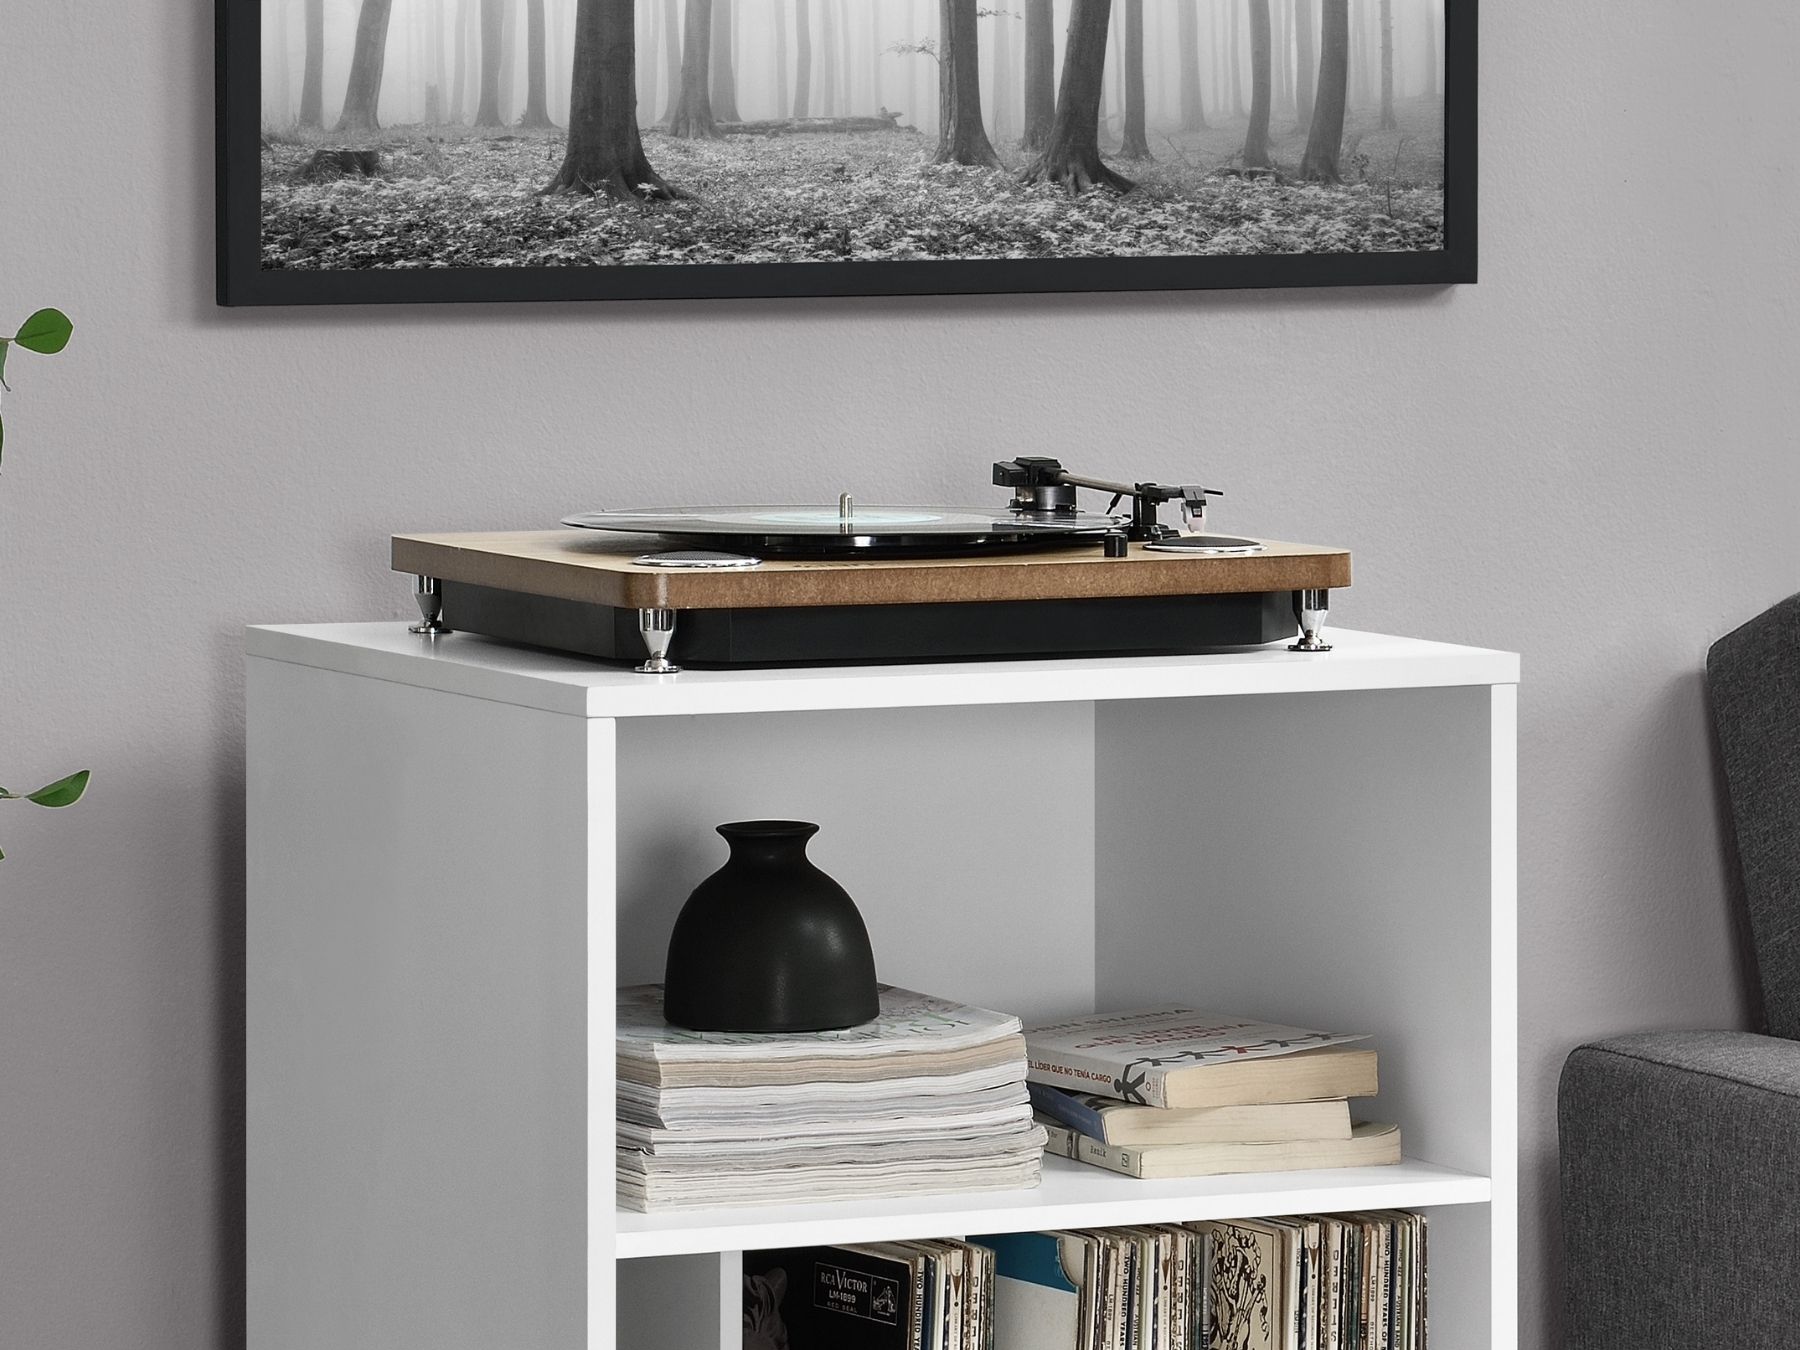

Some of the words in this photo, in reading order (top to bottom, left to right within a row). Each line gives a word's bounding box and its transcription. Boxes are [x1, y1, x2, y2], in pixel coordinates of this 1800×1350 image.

[1034, 1060, 1050, 1072] LÍDER
[1051, 1064, 1063, 1075] QUE
[1064, 1067, 1073, 1076] NO
[1074, 1069, 1089, 1079] TENÍA
[1091, 1073, 1112, 1084] CARGO
[821, 1272, 836, 1286] RCA
[836, 1269, 868, 1293] VICTOR
[914, 1294, 922, 1333] HUNDRED
[1381, 1332, 1387, 1342] OF
